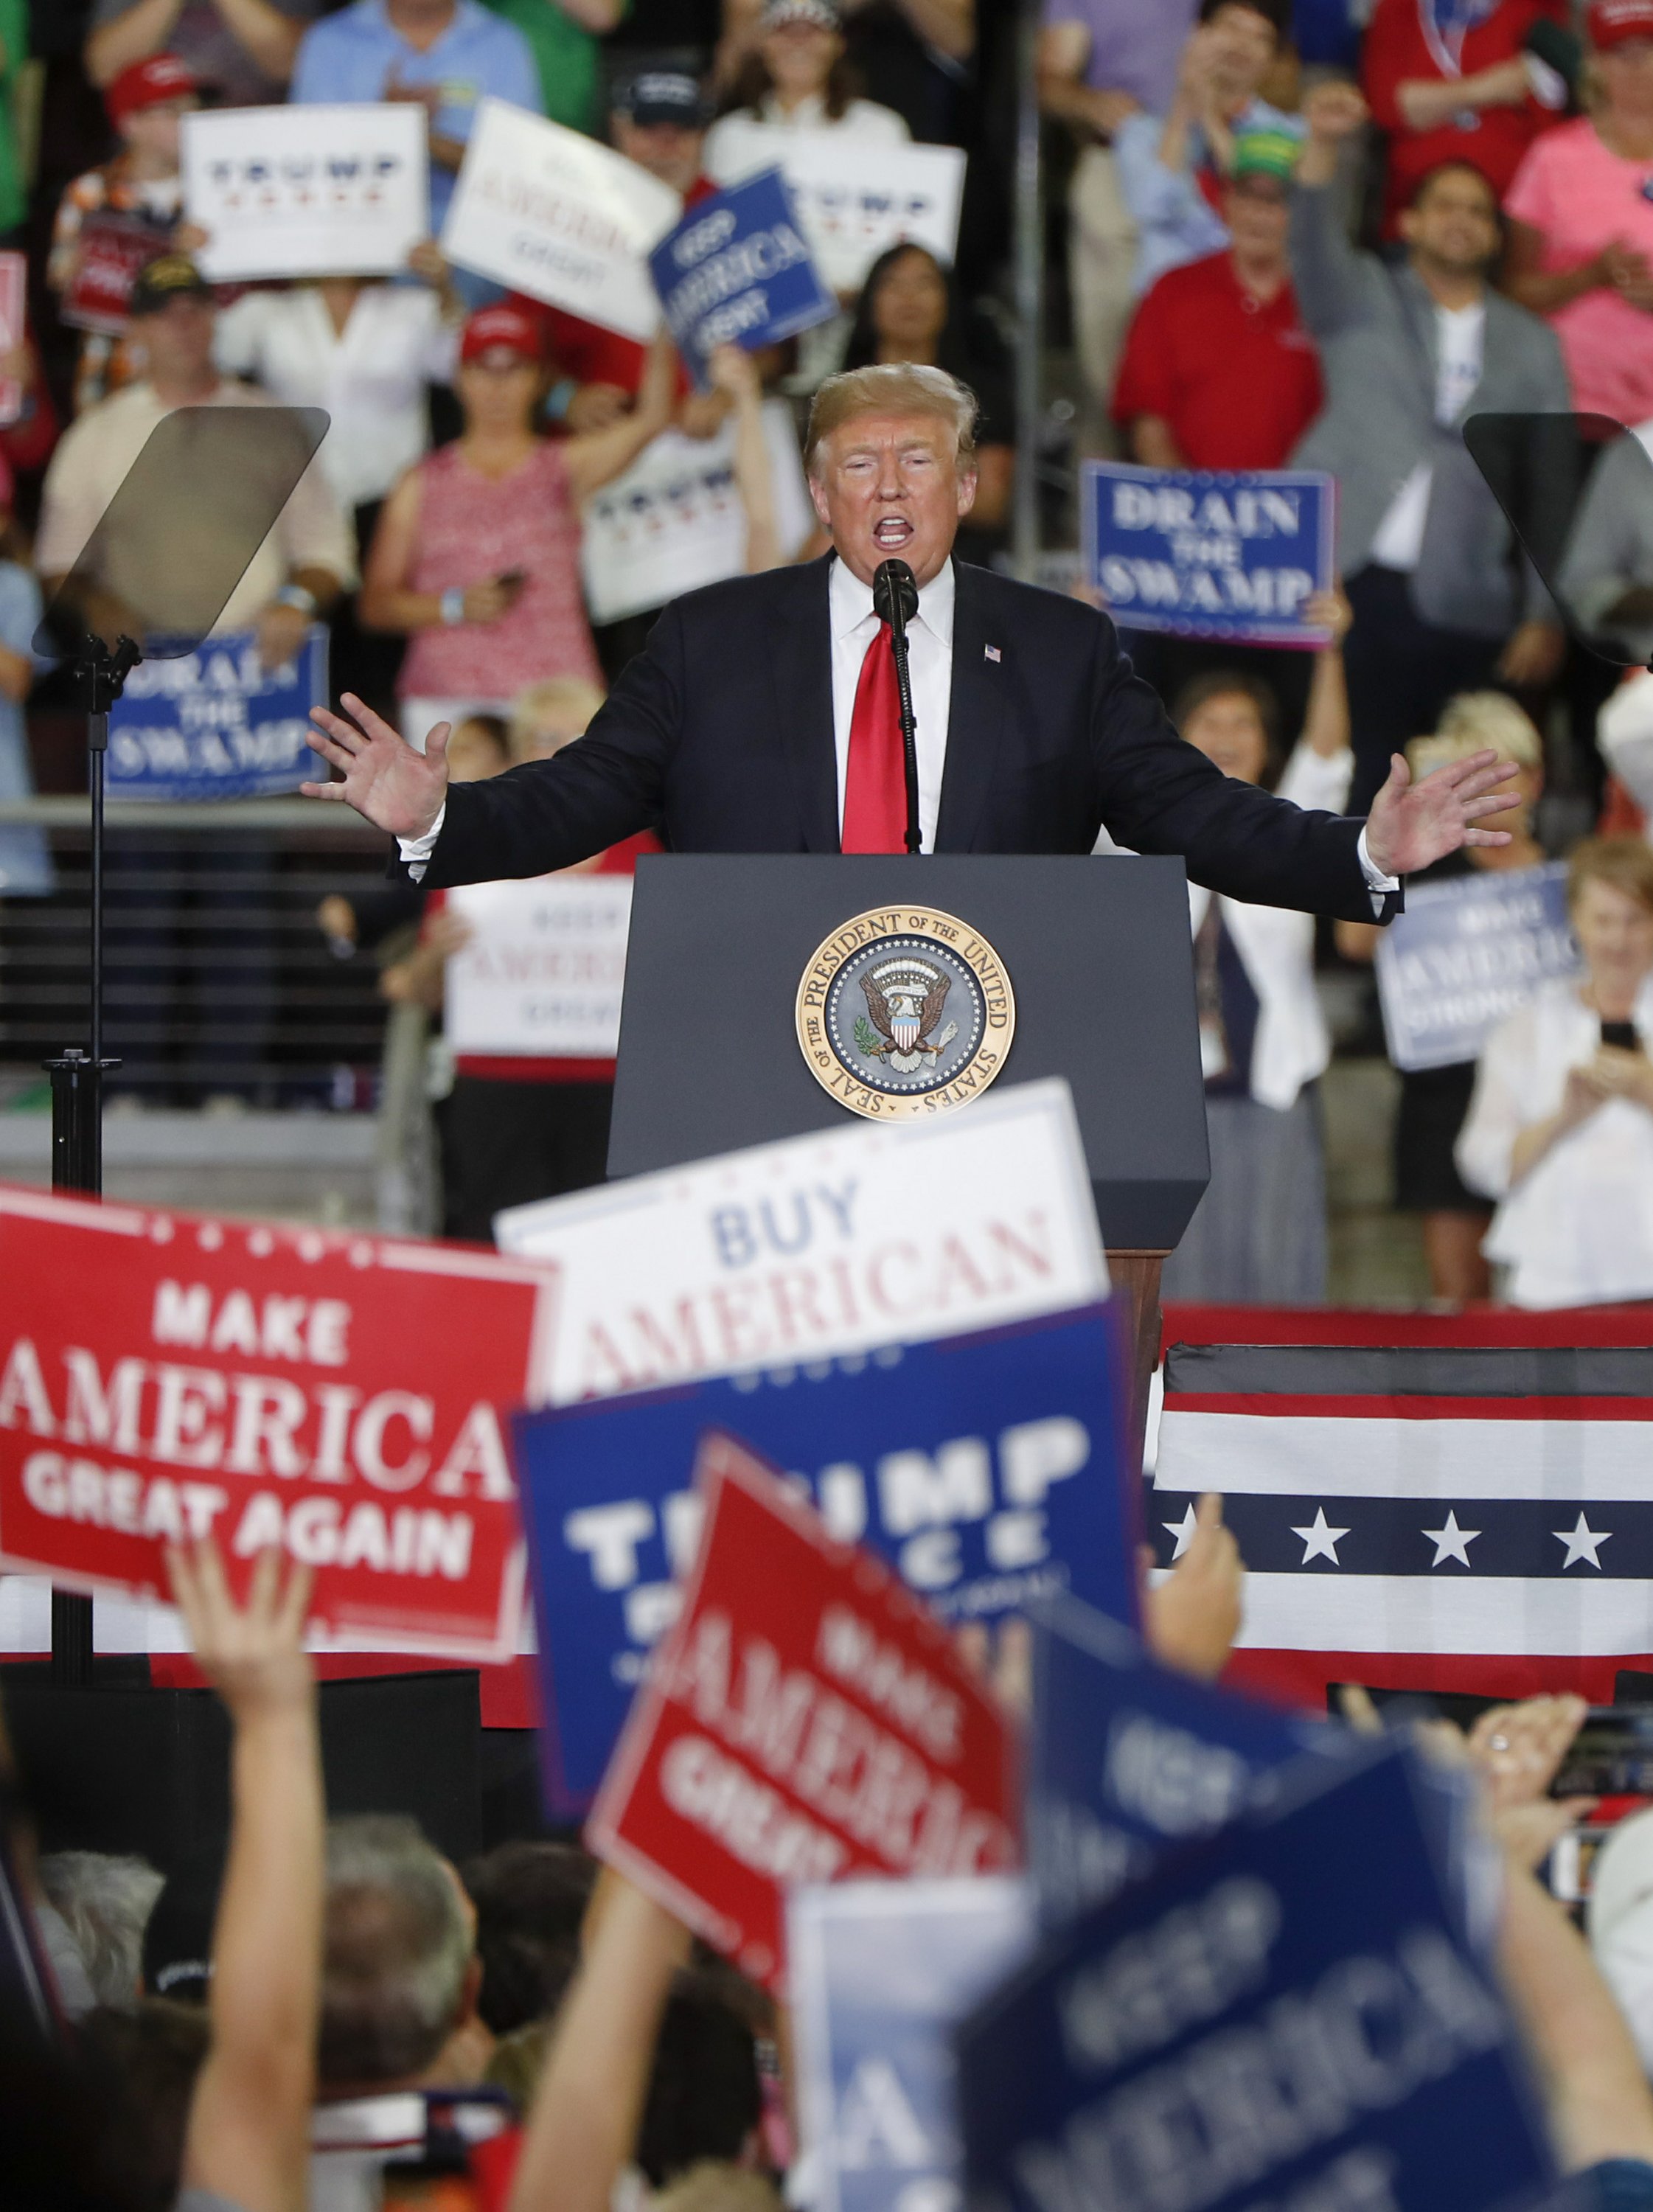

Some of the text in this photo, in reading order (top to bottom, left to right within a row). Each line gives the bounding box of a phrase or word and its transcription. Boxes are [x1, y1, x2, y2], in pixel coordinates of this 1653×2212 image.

[1113, 482, 1300, 540] DRAIN
[1172, 527, 1242, 569] THE
[1102, 556, 1313, 617] SWAMP
[111, 720, 307, 776] SWAMP
[178, 693, 248, 731] THE
[804, 914, 1008, 1113] SEAL OF THE PRESIDENT OF THE UNITED STATES
[709, 1178, 860, 1270] BUY
[152, 1279, 352, 1367] MAKE
[582, 1206, 1057, 1399] AMERICAN
[0, 1338, 518, 1502] AMERICA
[21, 1450, 476, 1580] GREAT AGAIN
[622, 1507, 1051, 1646] PCE
